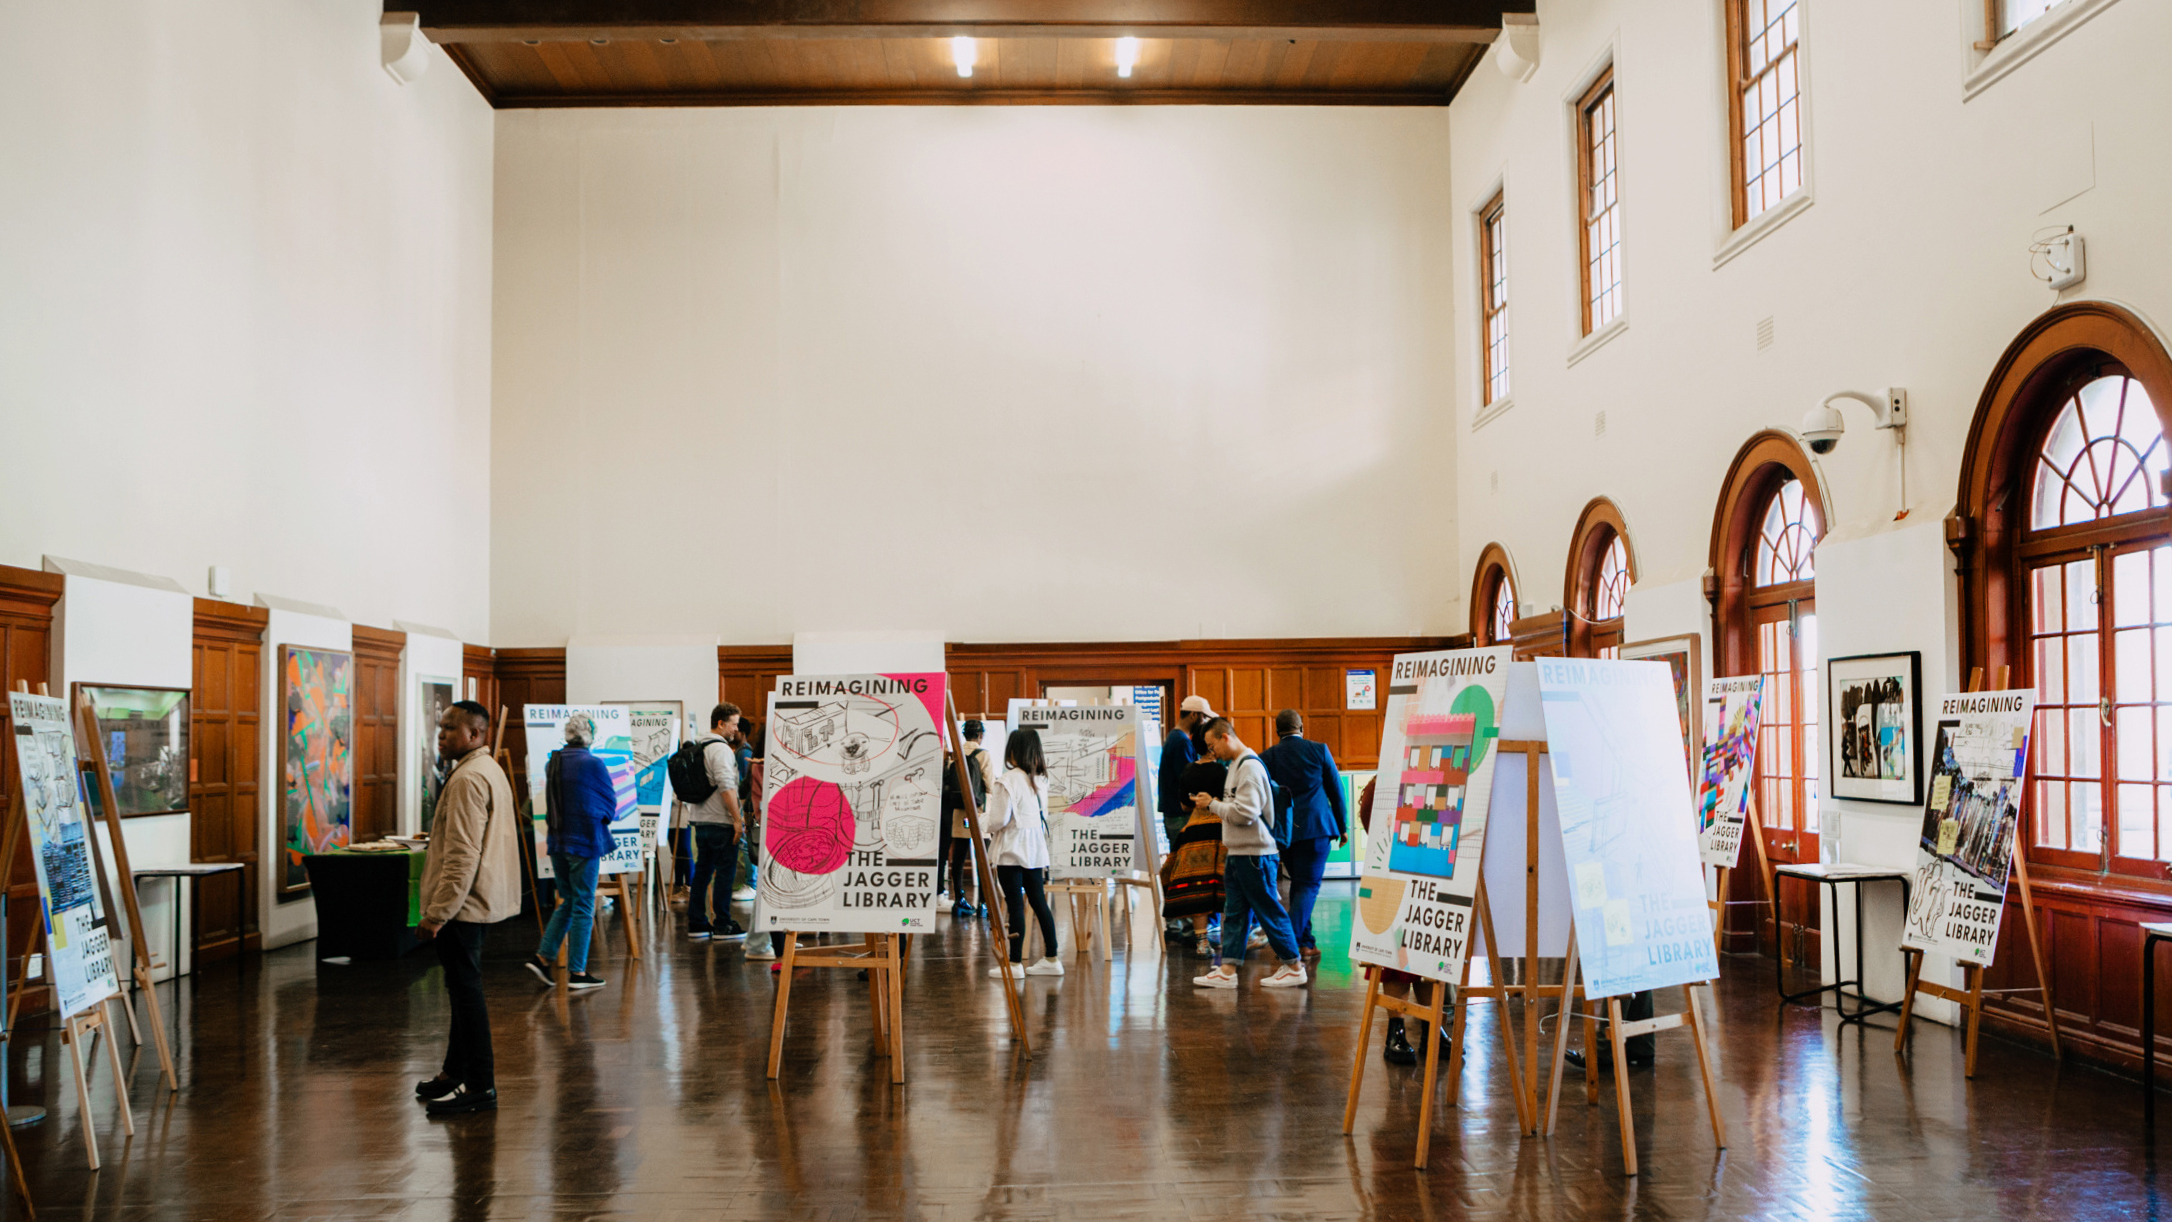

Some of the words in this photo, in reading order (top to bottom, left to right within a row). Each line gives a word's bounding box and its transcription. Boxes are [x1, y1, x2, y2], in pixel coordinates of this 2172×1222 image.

[1395, 655, 1497, 680] REIMAGINING
[782, 678, 929, 696] REIMAGINING
[1711, 679, 1759, 694] REIMAGINING
[13, 699, 65, 722] REIMAGINING
[1022, 709, 1125, 721] REIMAGINING
[1942, 696, 2023, 715] REIMAGINING
[631, 718, 667, 727] AGINING
[1716, 810, 1728, 822] THE
[1071, 829, 1098, 840] THE
[1712, 825, 1740, 838] JAGGER
[1070, 843, 1130, 854] JAGGER
[1710, 839, 1738, 853] LIBRARY
[845, 851, 884, 867] THE
[1070, 856, 1131, 867] LIBRARY
[843, 871, 929, 887] JAGGER
[1410, 879, 1437, 901] THE
[1953, 881, 1975, 900] THE
[843, 892, 932, 908] LIBRARY
[1639, 893, 1669, 913] THE
[1405, 904, 1464, 933] JAGGER
[1948, 902, 1997, 925] JAGGER
[76, 914, 91, 934] THE
[1645, 914, 1707, 940] JAGGER
[1945, 921, 1995, 946] LIBRARY
[81, 932, 108, 959] JAGGER
[1400, 928, 1463, 959] LIBRARY
[1647, 936, 1711, 966] LIBRARY
[85, 955, 113, 983] LIBRARY
